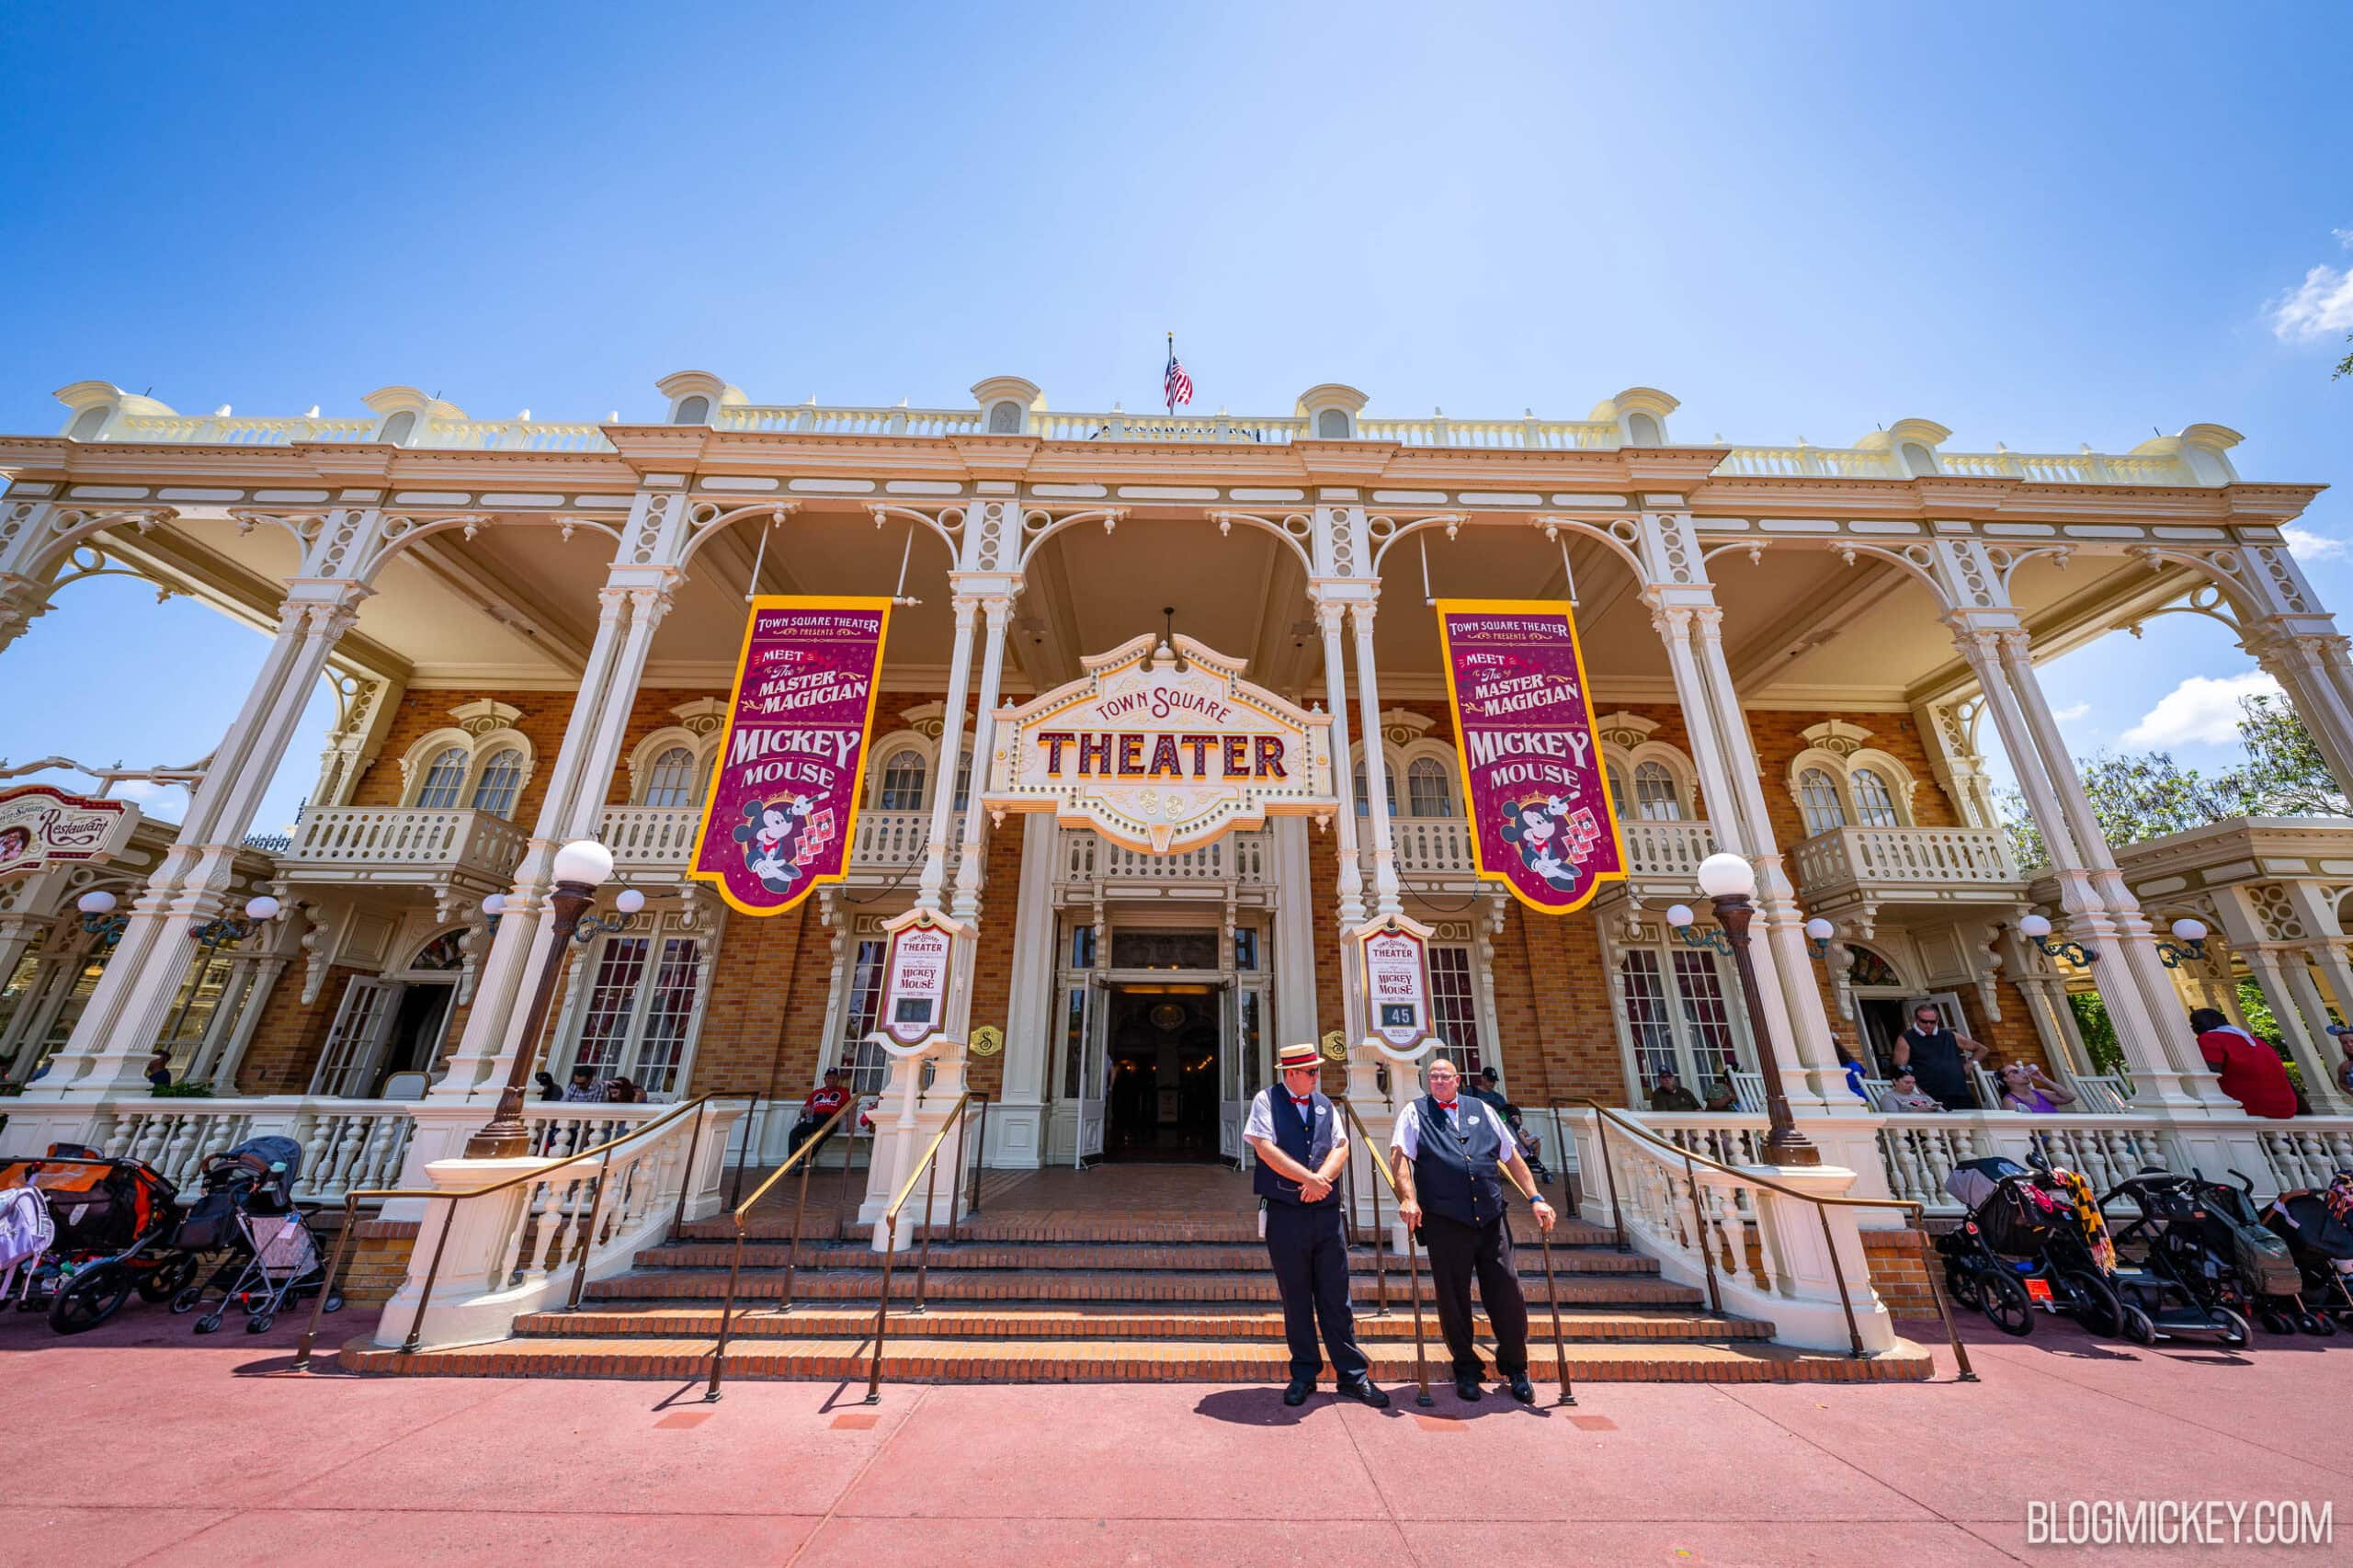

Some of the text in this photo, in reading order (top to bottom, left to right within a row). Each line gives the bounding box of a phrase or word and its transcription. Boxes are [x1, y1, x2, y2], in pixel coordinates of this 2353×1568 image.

[758, 616, 879, 633] TOWN SQUARE THEATER
[799, 628, 834, 637] PRESENTS
[1449, 621, 1568, 638] TOWN SQUARE THEATER
[1493, 632, 1527, 641] PRESENTS
[762, 650, 804, 663] MEET
[1466, 653, 1506, 666] MEET
[770, 664, 795, 679] The
[1481, 667, 1502, 682] The
[758, 670, 836, 698] MASTER
[1474, 673, 1545, 699] MASTER
[760, 680, 869, 715] MAGICIAN
[1096, 687, 1232, 724] TOWN SQUARE
[1483, 683, 1579, 718] MAGICIAN
[727, 728, 861, 770] MICKEY
[1037, 733, 1288, 780] THEATER
[1468, 731, 1589, 771] MICKEY
[740, 761, 835, 790] MOUSE
[1490, 763, 1581, 791] MOUSE
[39, 809, 108, 846] Restaurant
[903, 943, 942, 952] THEATER
[1372, 949, 1413, 958] THEATER
[901, 969, 937, 979] MICKEY
[1378, 974, 1413, 985] MICKEY
[900, 979, 935, 989] MOUSE
[1379, 985, 1414, 995] MOUSE
[1392, 1008, 1410, 1023] 45
